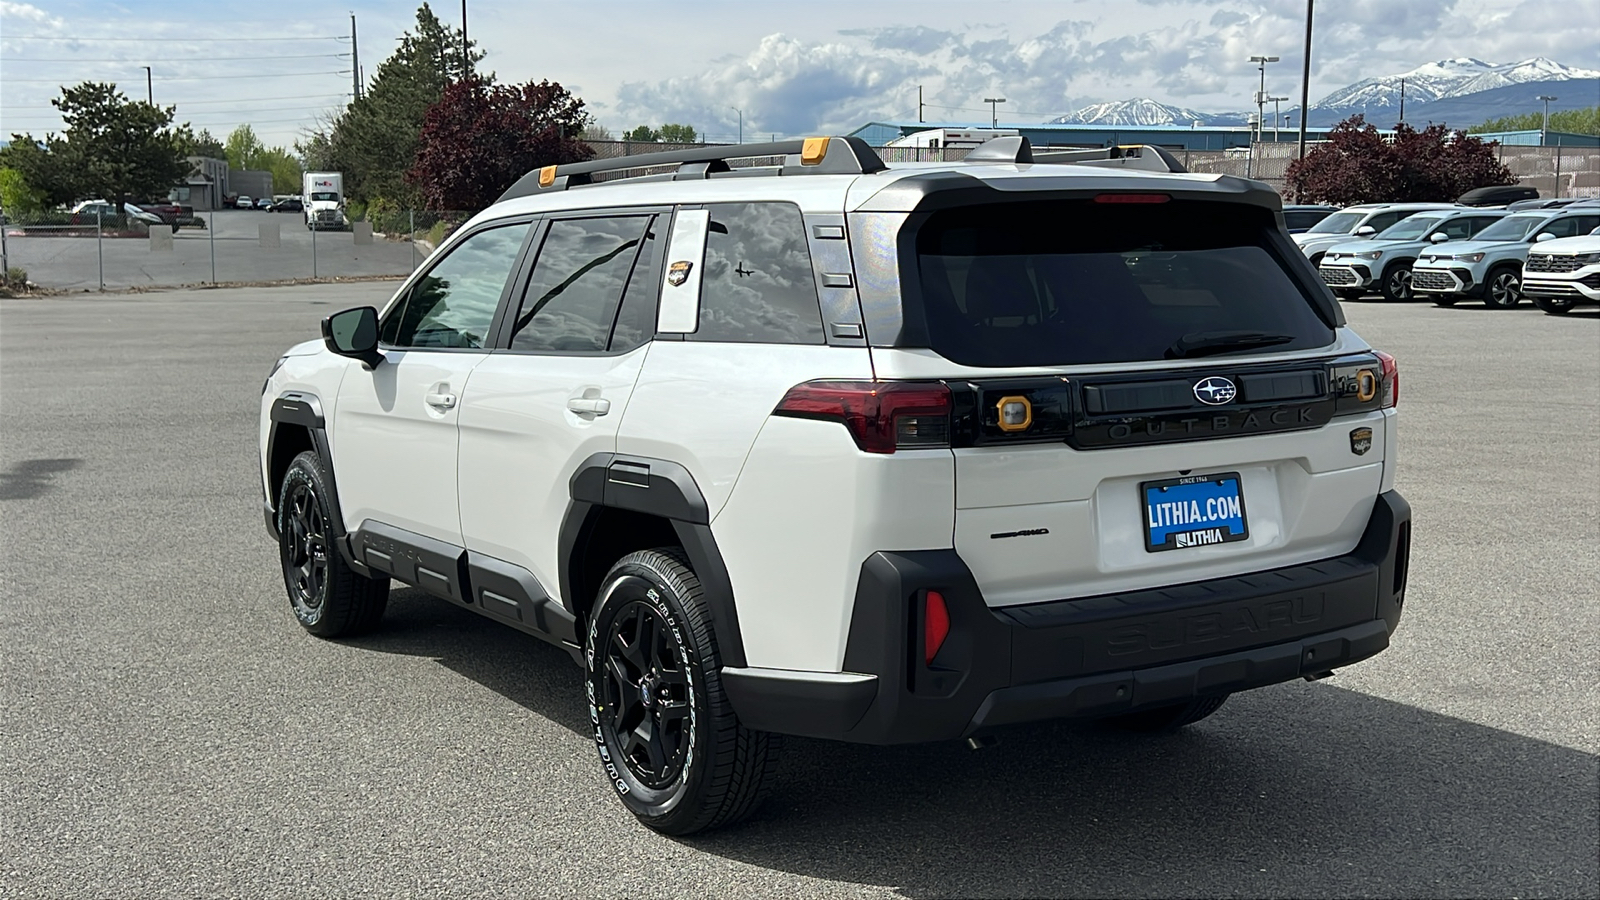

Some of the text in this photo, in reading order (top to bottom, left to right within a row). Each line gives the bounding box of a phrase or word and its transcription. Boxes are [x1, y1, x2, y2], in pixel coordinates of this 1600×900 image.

[1108, 408, 1314, 440] OUTBACK
[1179, 477, 1195, 485] SINCE
[1148, 495, 1242, 528] LITHIA.COM
[1186, 528, 1223, 547] LITHIA
[1107, 592, 1325, 656] SUBARU
